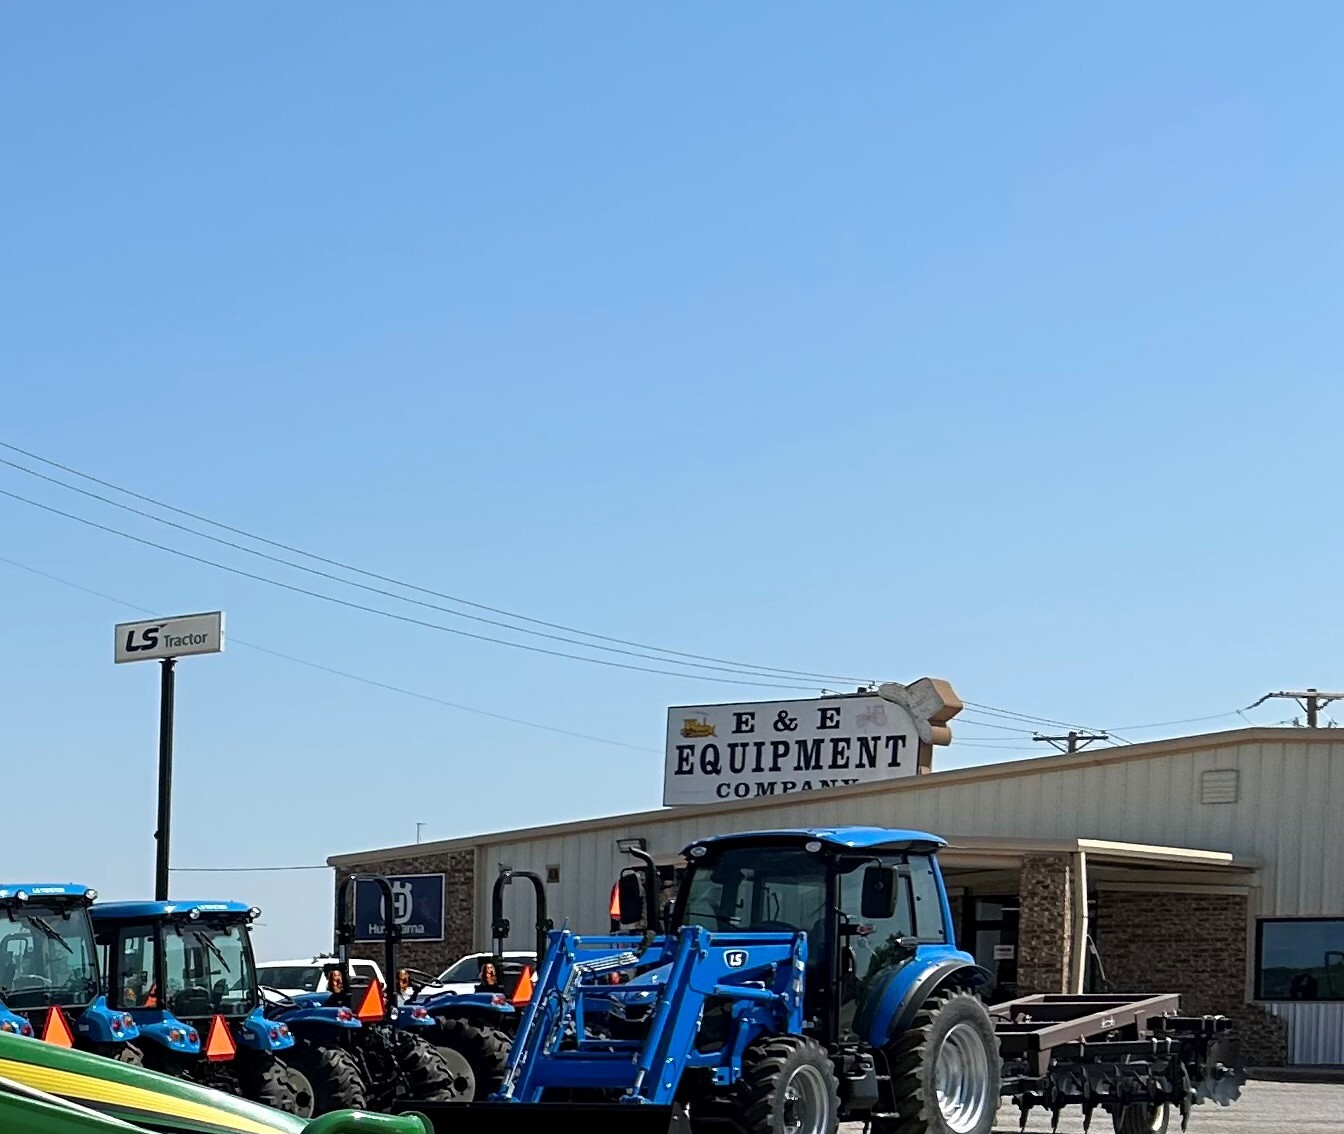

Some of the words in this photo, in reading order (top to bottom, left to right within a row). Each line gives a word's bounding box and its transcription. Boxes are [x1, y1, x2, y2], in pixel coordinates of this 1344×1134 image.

[125, 625, 162, 652] LS
[163, 633, 208, 648] Tractor
[731, 711, 756, 735] E
[772, 710, 799, 733] &
[816, 707, 842, 731] E
[674, 735, 907, 776] EQUIPMENT
[729, 953, 743, 967] LS
